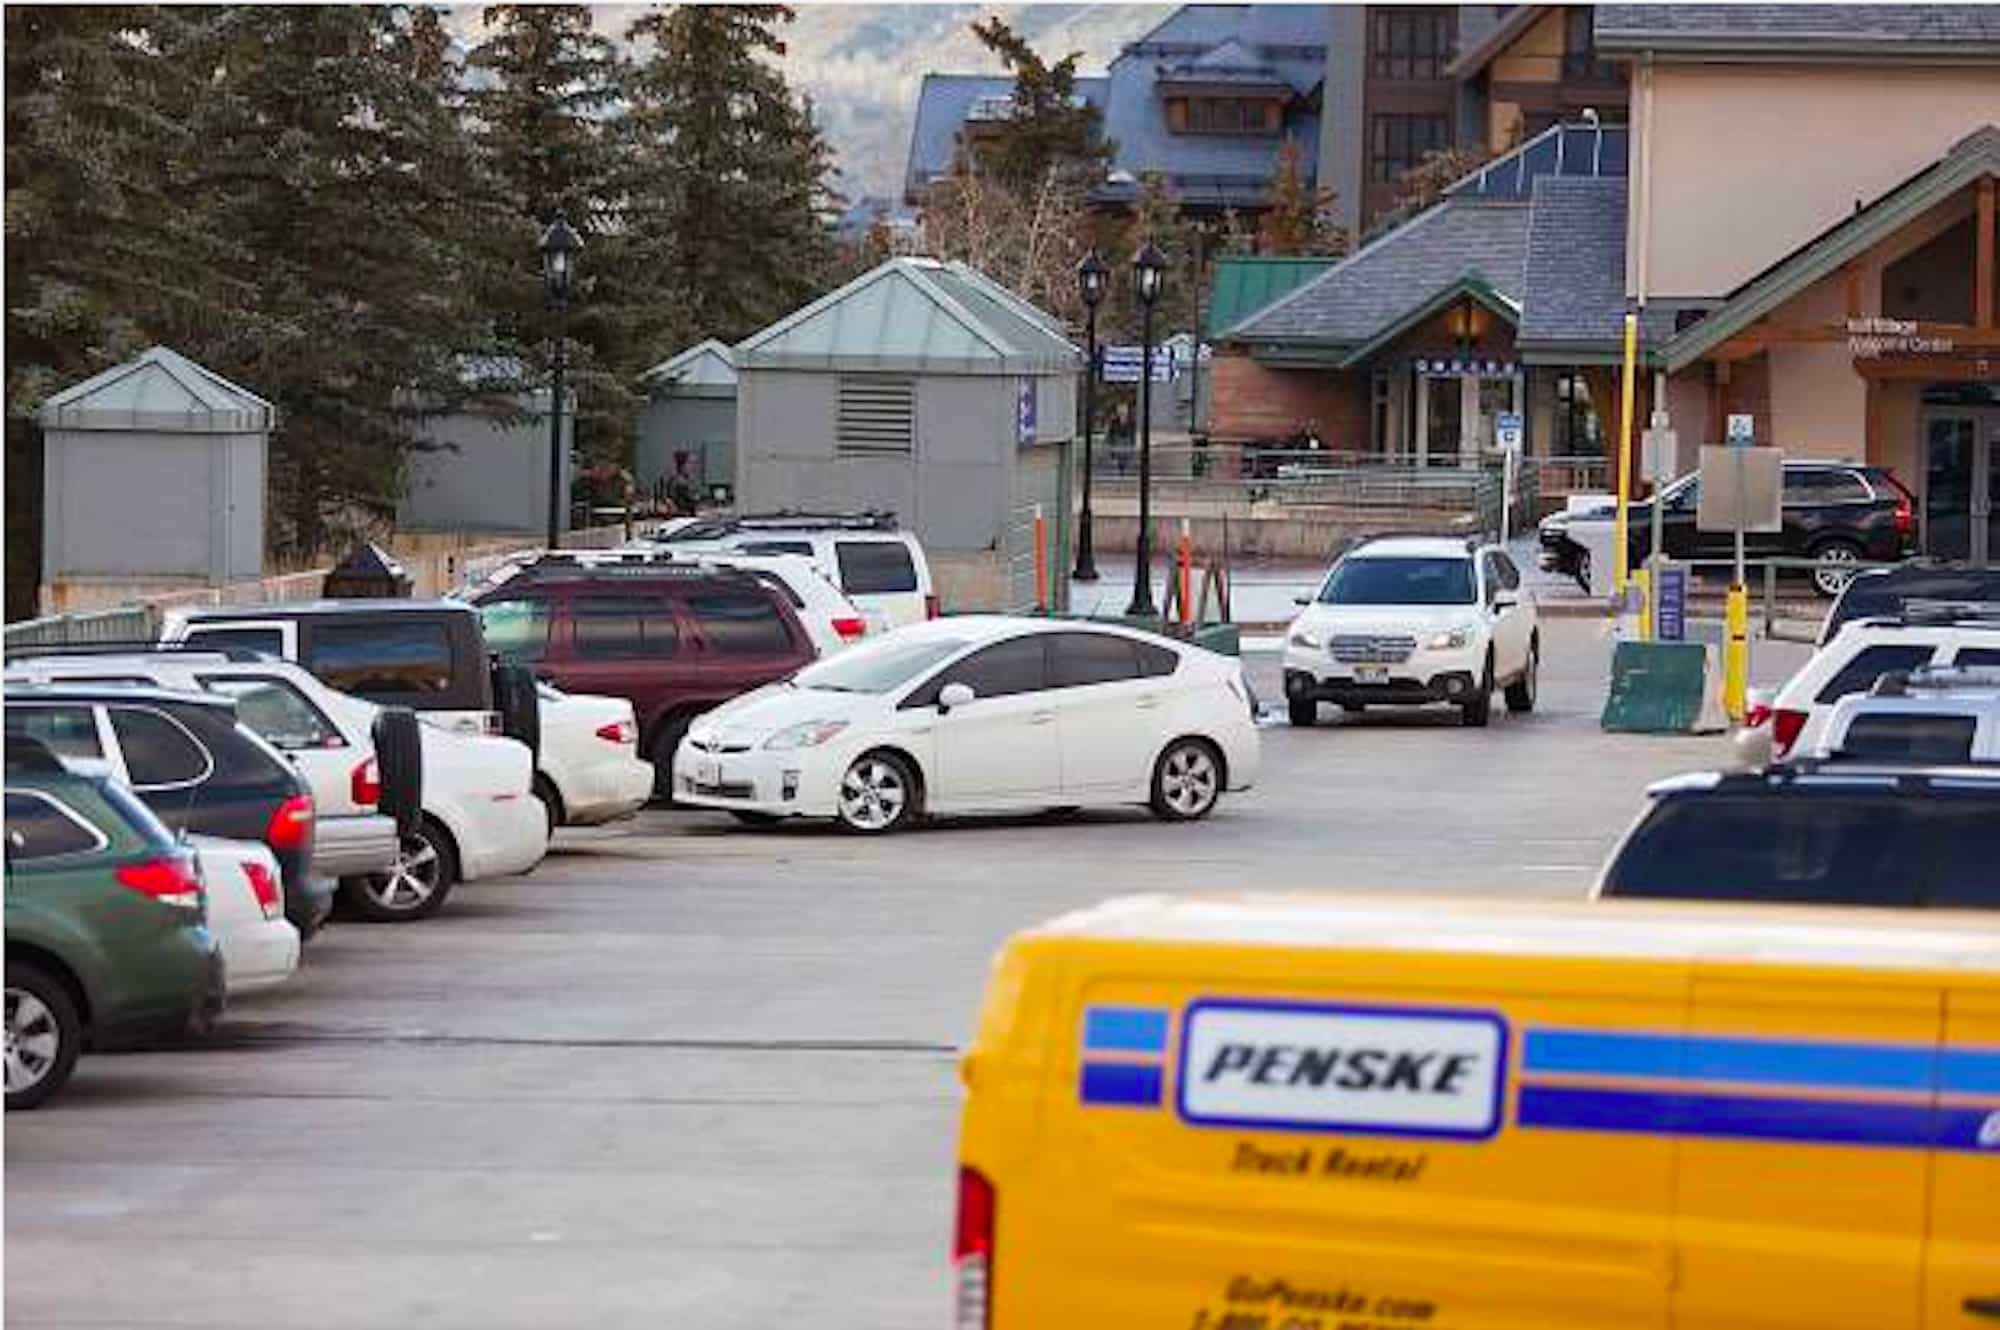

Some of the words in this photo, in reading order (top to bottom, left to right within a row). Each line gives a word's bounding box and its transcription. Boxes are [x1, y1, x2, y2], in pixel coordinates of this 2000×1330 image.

[1203, 1044, 1479, 1094] PENSKE
[1231, 1143, 1312, 1174] Truck
[1322, 1148, 1426, 1181] Rental
[1226, 1275, 1437, 1319] GoPenske.com
